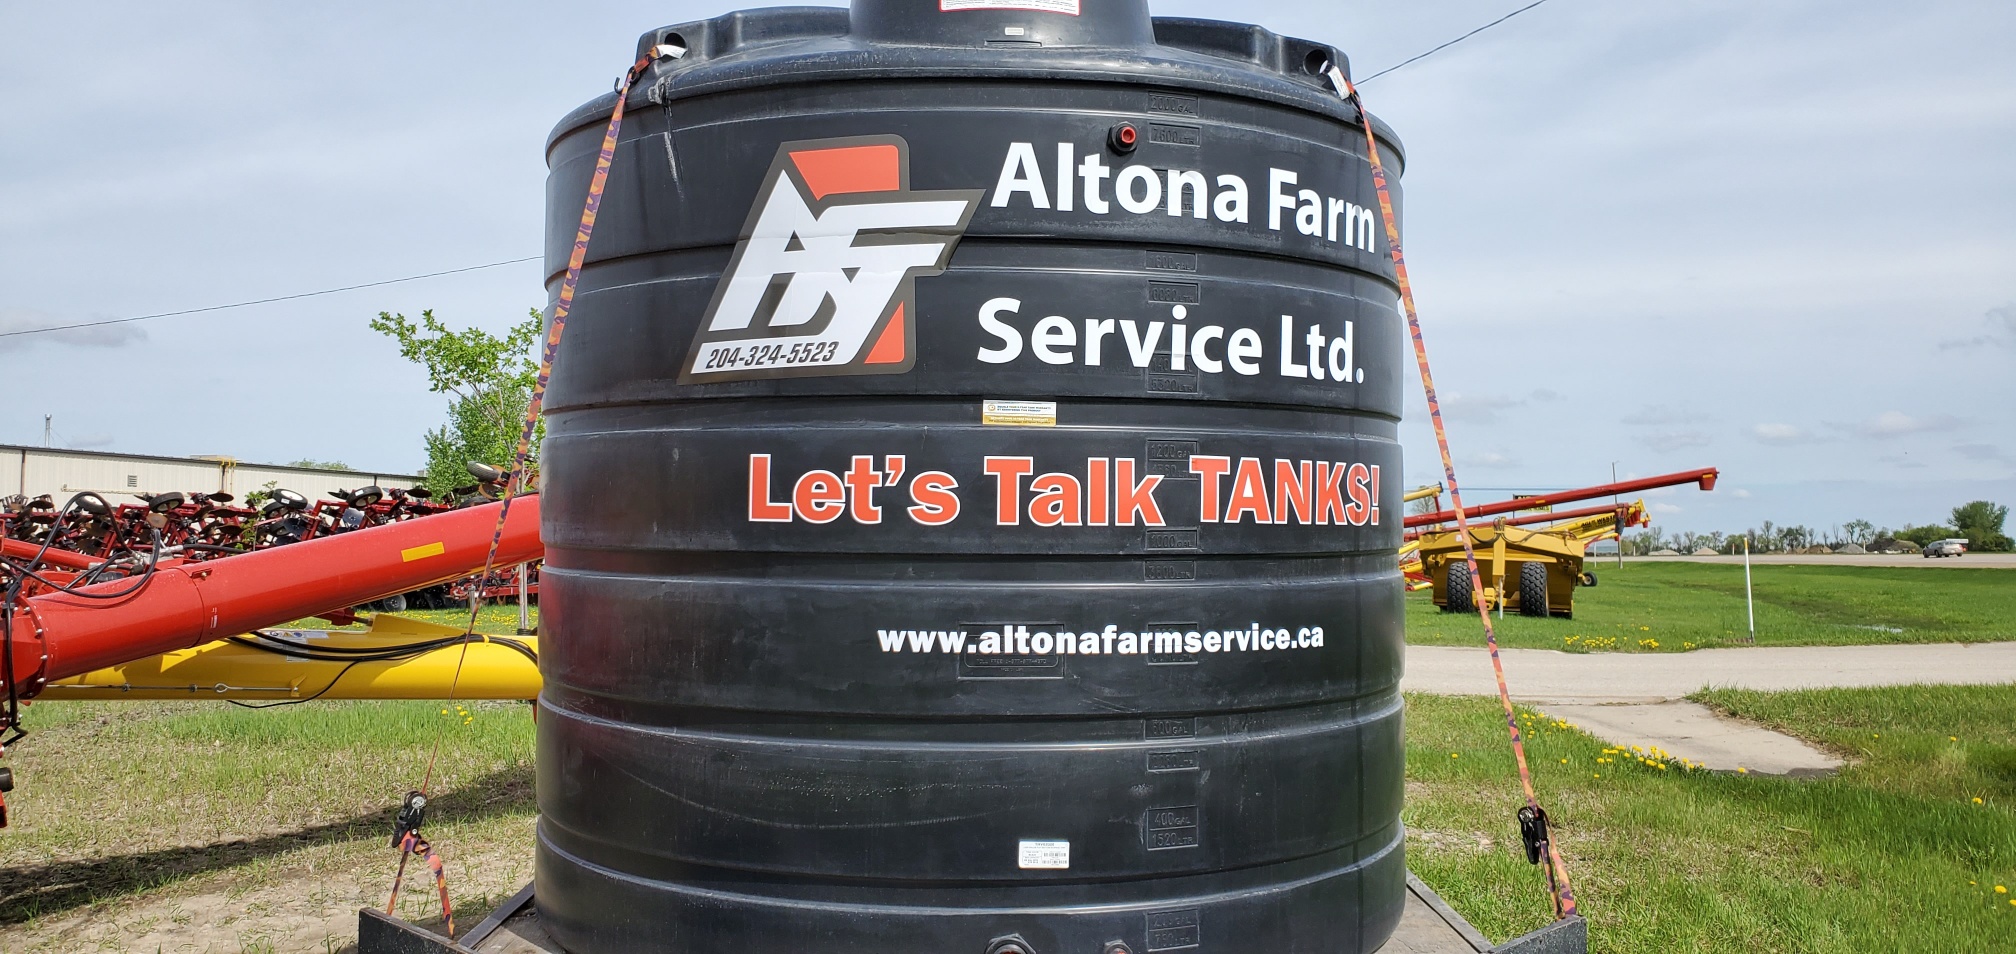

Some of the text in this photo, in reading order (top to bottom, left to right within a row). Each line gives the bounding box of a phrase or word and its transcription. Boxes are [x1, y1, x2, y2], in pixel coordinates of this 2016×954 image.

[990, 142, 1376, 254] Altona Farm
[706, 341, 840, 369] 204-324-5523
[977, 297, 1365, 384] Service Ltd.
[747, 453, 1380, 527] Let's Talk TANKS!
[877, 623, 1325, 655] www.altonafarmservice.ca
